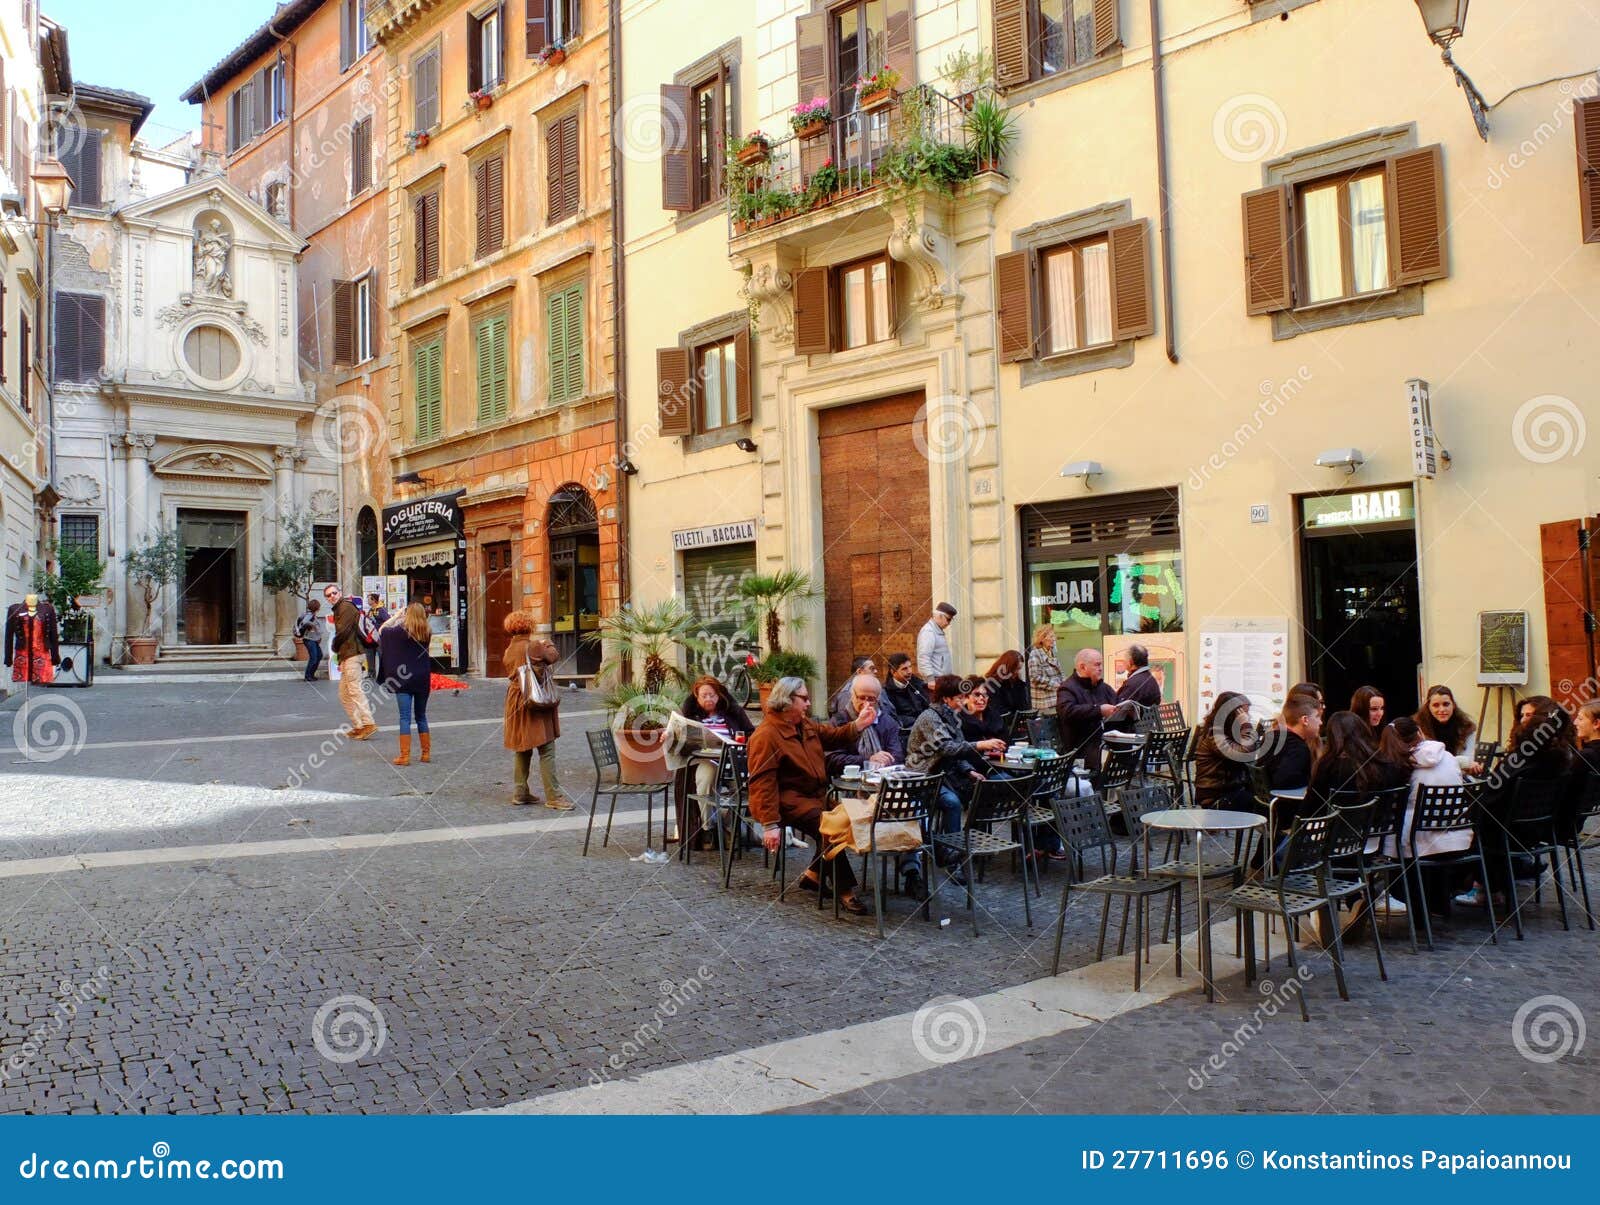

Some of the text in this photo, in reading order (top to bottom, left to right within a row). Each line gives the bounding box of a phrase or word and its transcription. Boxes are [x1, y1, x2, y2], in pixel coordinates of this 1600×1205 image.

[1409, 384, 1423, 470] TABACCHI
[384, 502, 453, 532] YOGURTERIA
[1351, 491, 1401, 520] BAR
[674, 529, 705, 547] FILETTI
[1055, 580, 1094, 604] BAR
